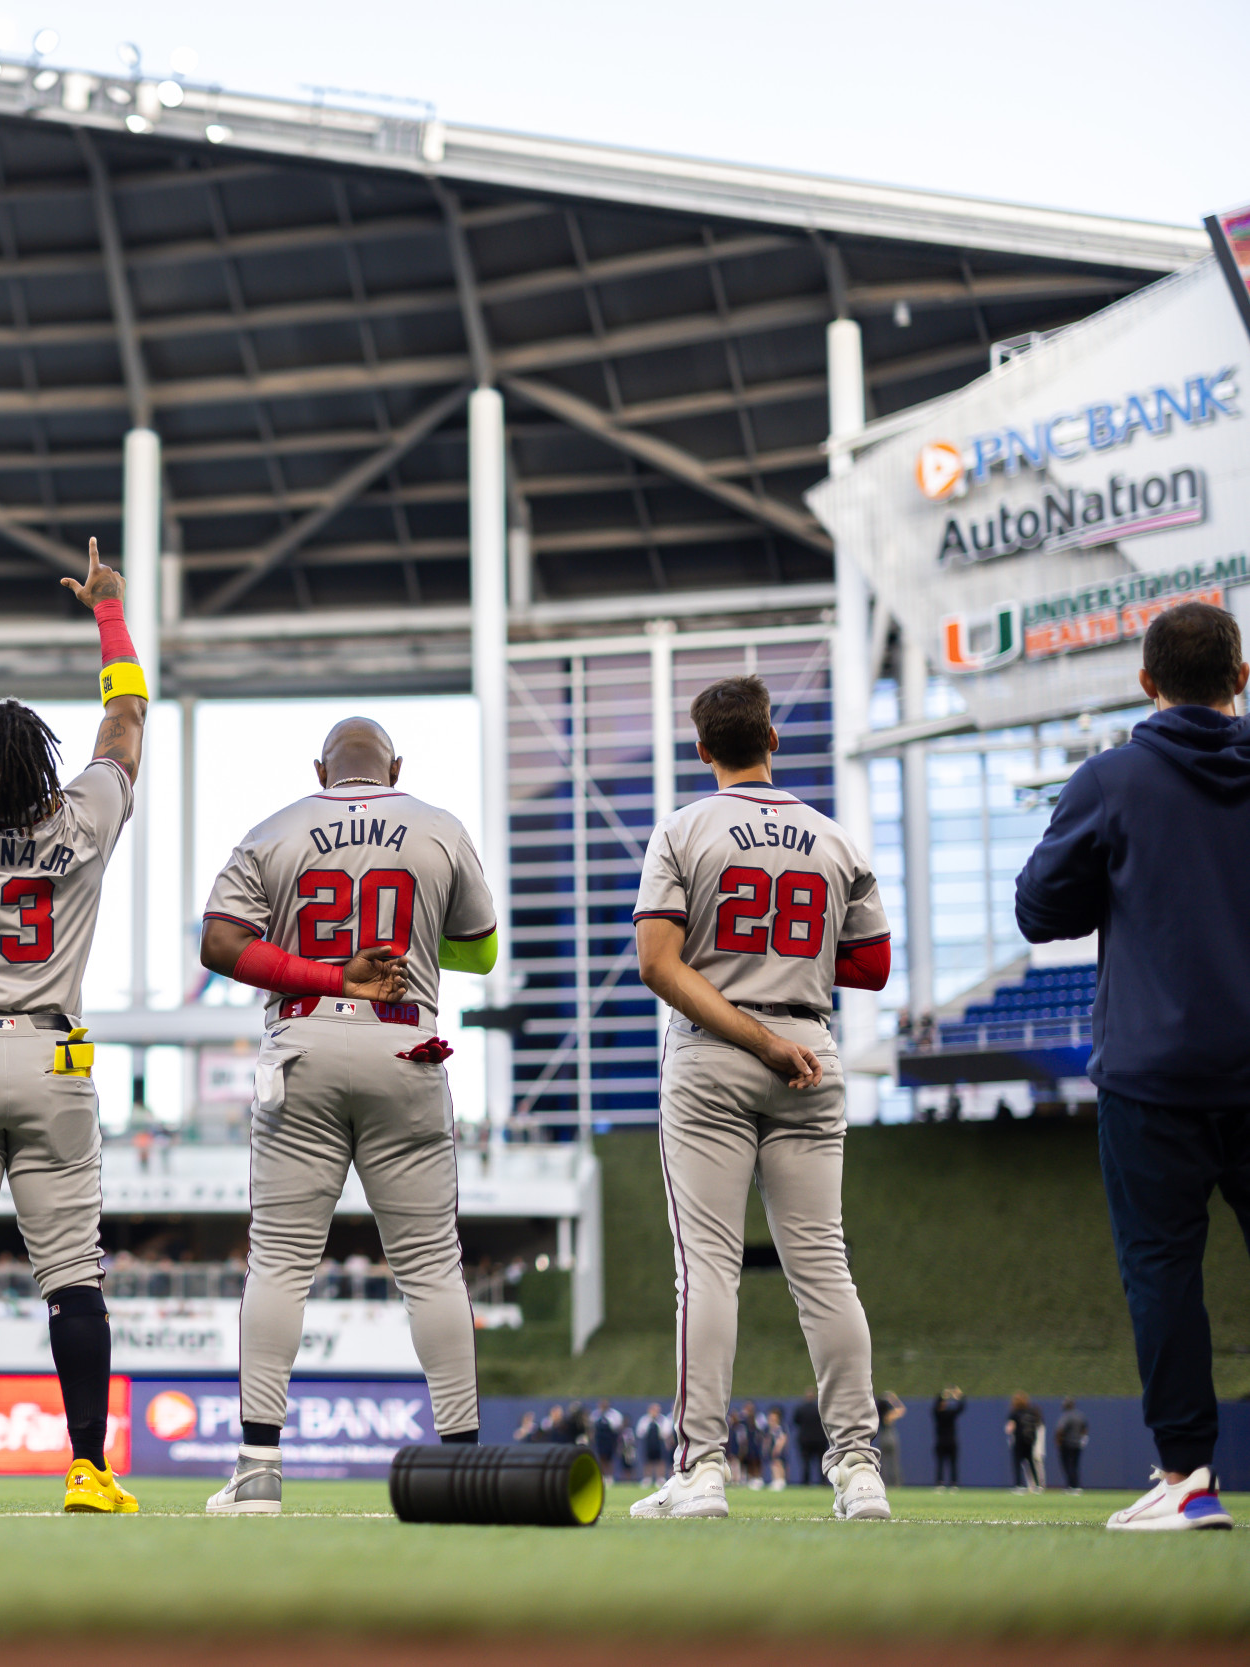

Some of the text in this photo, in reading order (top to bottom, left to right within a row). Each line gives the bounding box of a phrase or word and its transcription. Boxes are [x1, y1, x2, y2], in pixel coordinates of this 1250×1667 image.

[939, 468, 1200, 562] AutoNation
[1025, 575, 1167, 623] UNIVERSITY
[1174, 563, 1207, 589] OF
[1025, 610, 1119, 658] HEALTH
[40, 844, 75, 875] JR
[309, 818, 408, 854] OZUNA
[728, 822, 817, 856] OLSON
[297, 868, 416, 959] 20
[714, 865, 828, 959] 28
